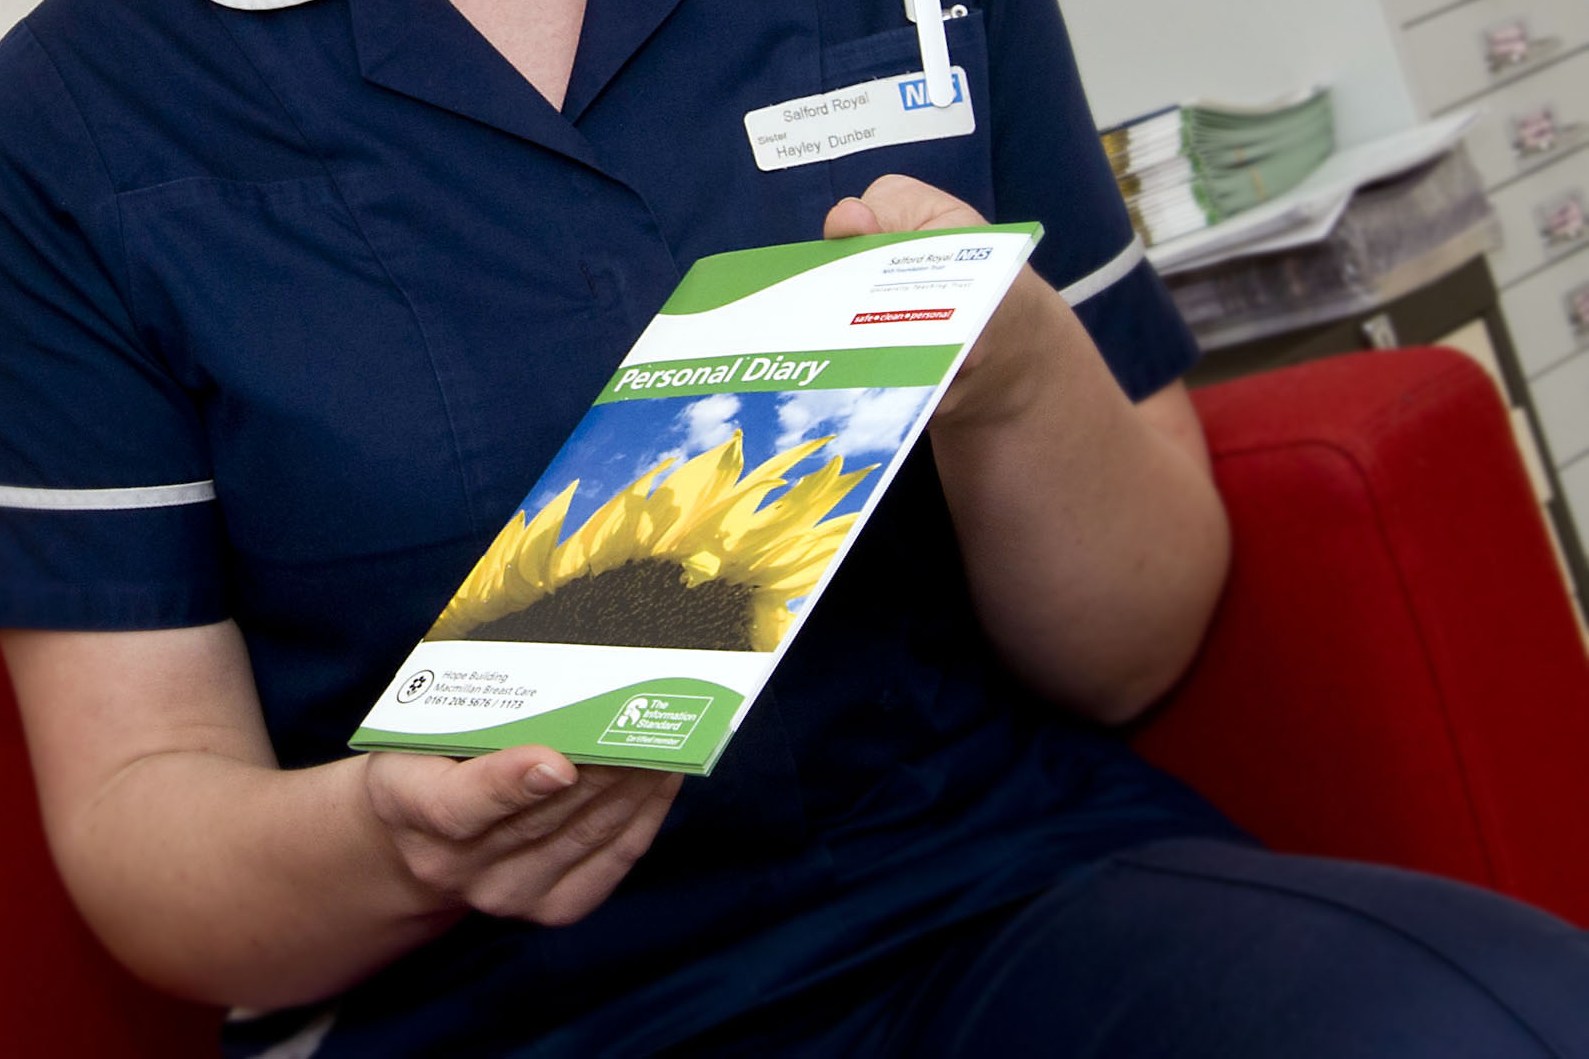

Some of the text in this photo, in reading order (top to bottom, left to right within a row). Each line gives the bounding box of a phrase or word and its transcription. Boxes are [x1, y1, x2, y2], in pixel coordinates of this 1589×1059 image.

[783, 92, 869, 122] Salford Royal
[776, 127, 877, 159] Hayley Dunbar
[890, 248, 992, 266] Salford Royal NHS
[614, 356, 831, 392] Personal Diary
[442, 671, 509, 684] Hope Building
[433, 683, 538, 697] Macmillan Breast Care
[424, 696, 448, 706] 0161
[650, 699, 669, 709] The
[643, 709, 697, 721] Information
[636, 719, 682, 731] Standard
